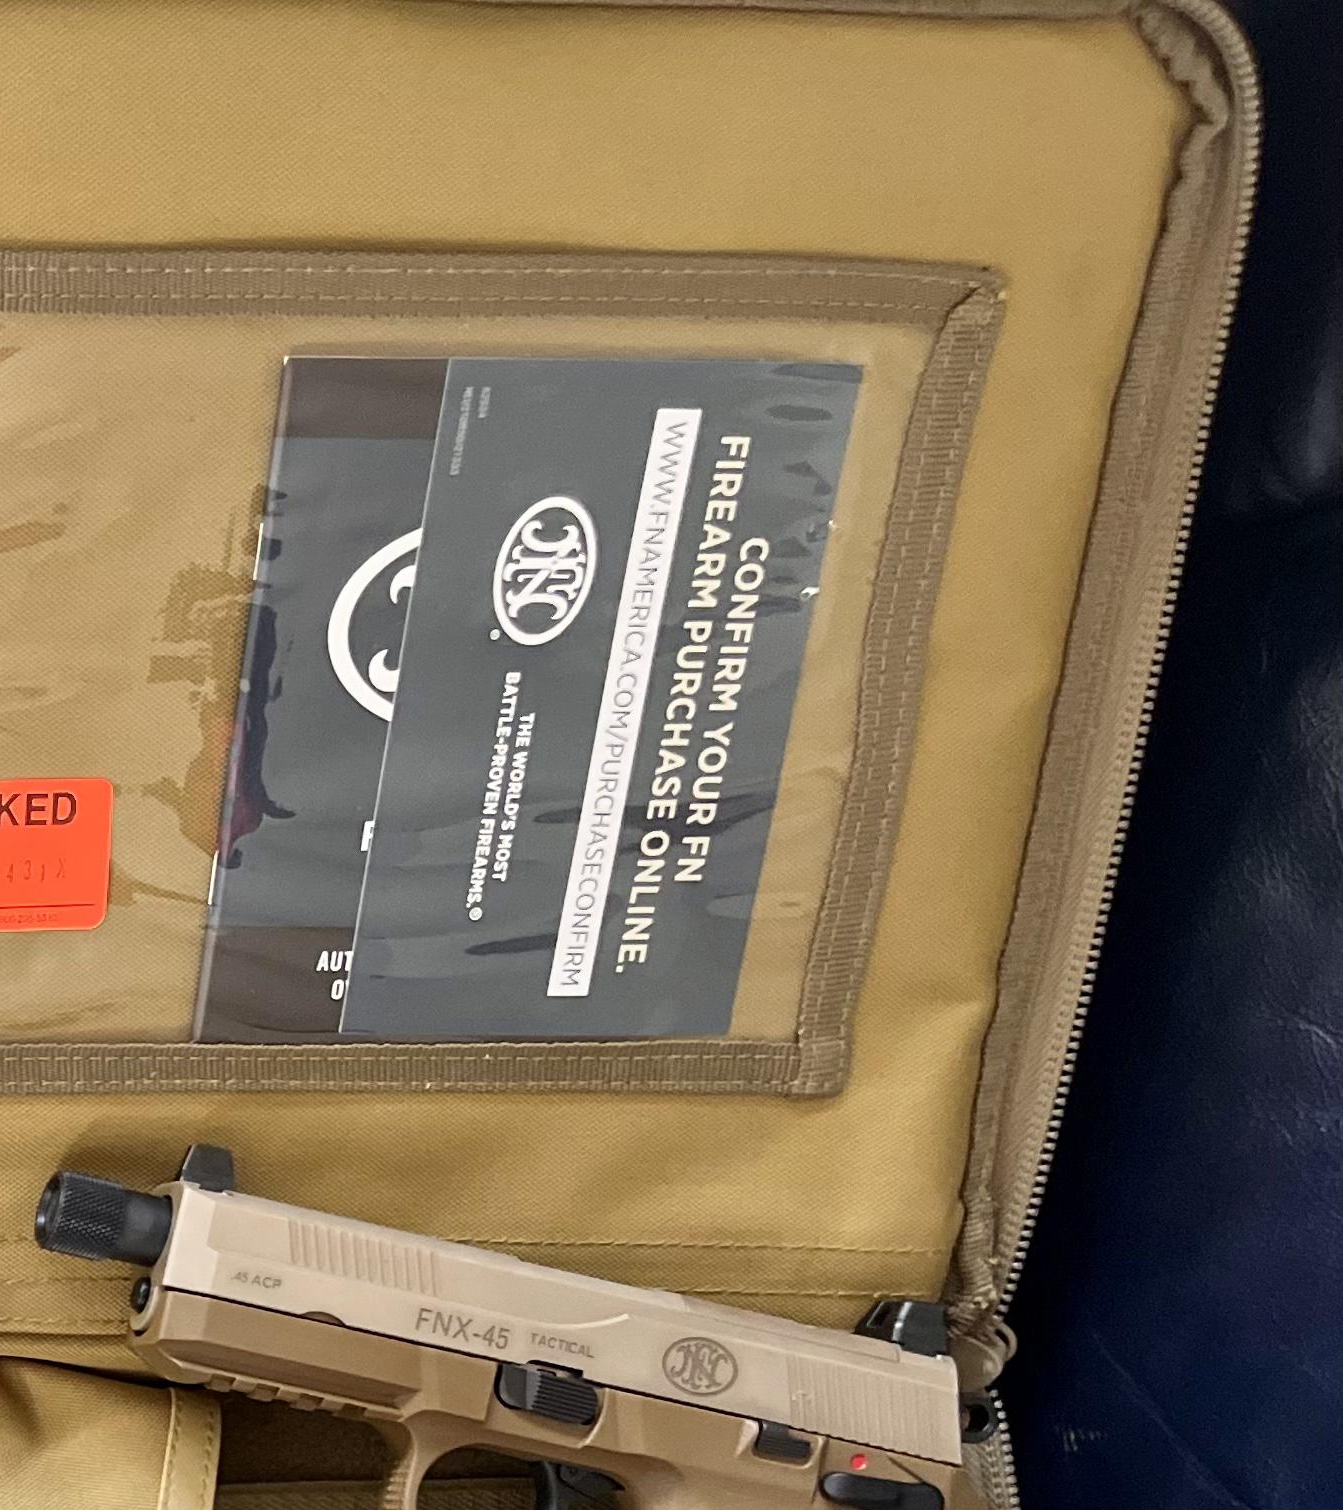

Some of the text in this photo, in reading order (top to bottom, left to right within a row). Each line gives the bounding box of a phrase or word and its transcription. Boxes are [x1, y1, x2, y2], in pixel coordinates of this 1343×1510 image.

[482, 671, 521, 816] BATTLE-PROVEN
[561, 420, 688, 988] WWW.FNAMERICA.COM/PURCHASECONFIRM
[615, 435, 751, 973] FIREARM PURCHASE ONLINE.
[673, 537, 770, 882] CONFIRM YOUR FN
[492, 712, 536, 882] THE WORLD'S MOST
[251, 1274, 282, 1289] ACP
[415, 1307, 596, 1359] FNX-45 TACTICAL
